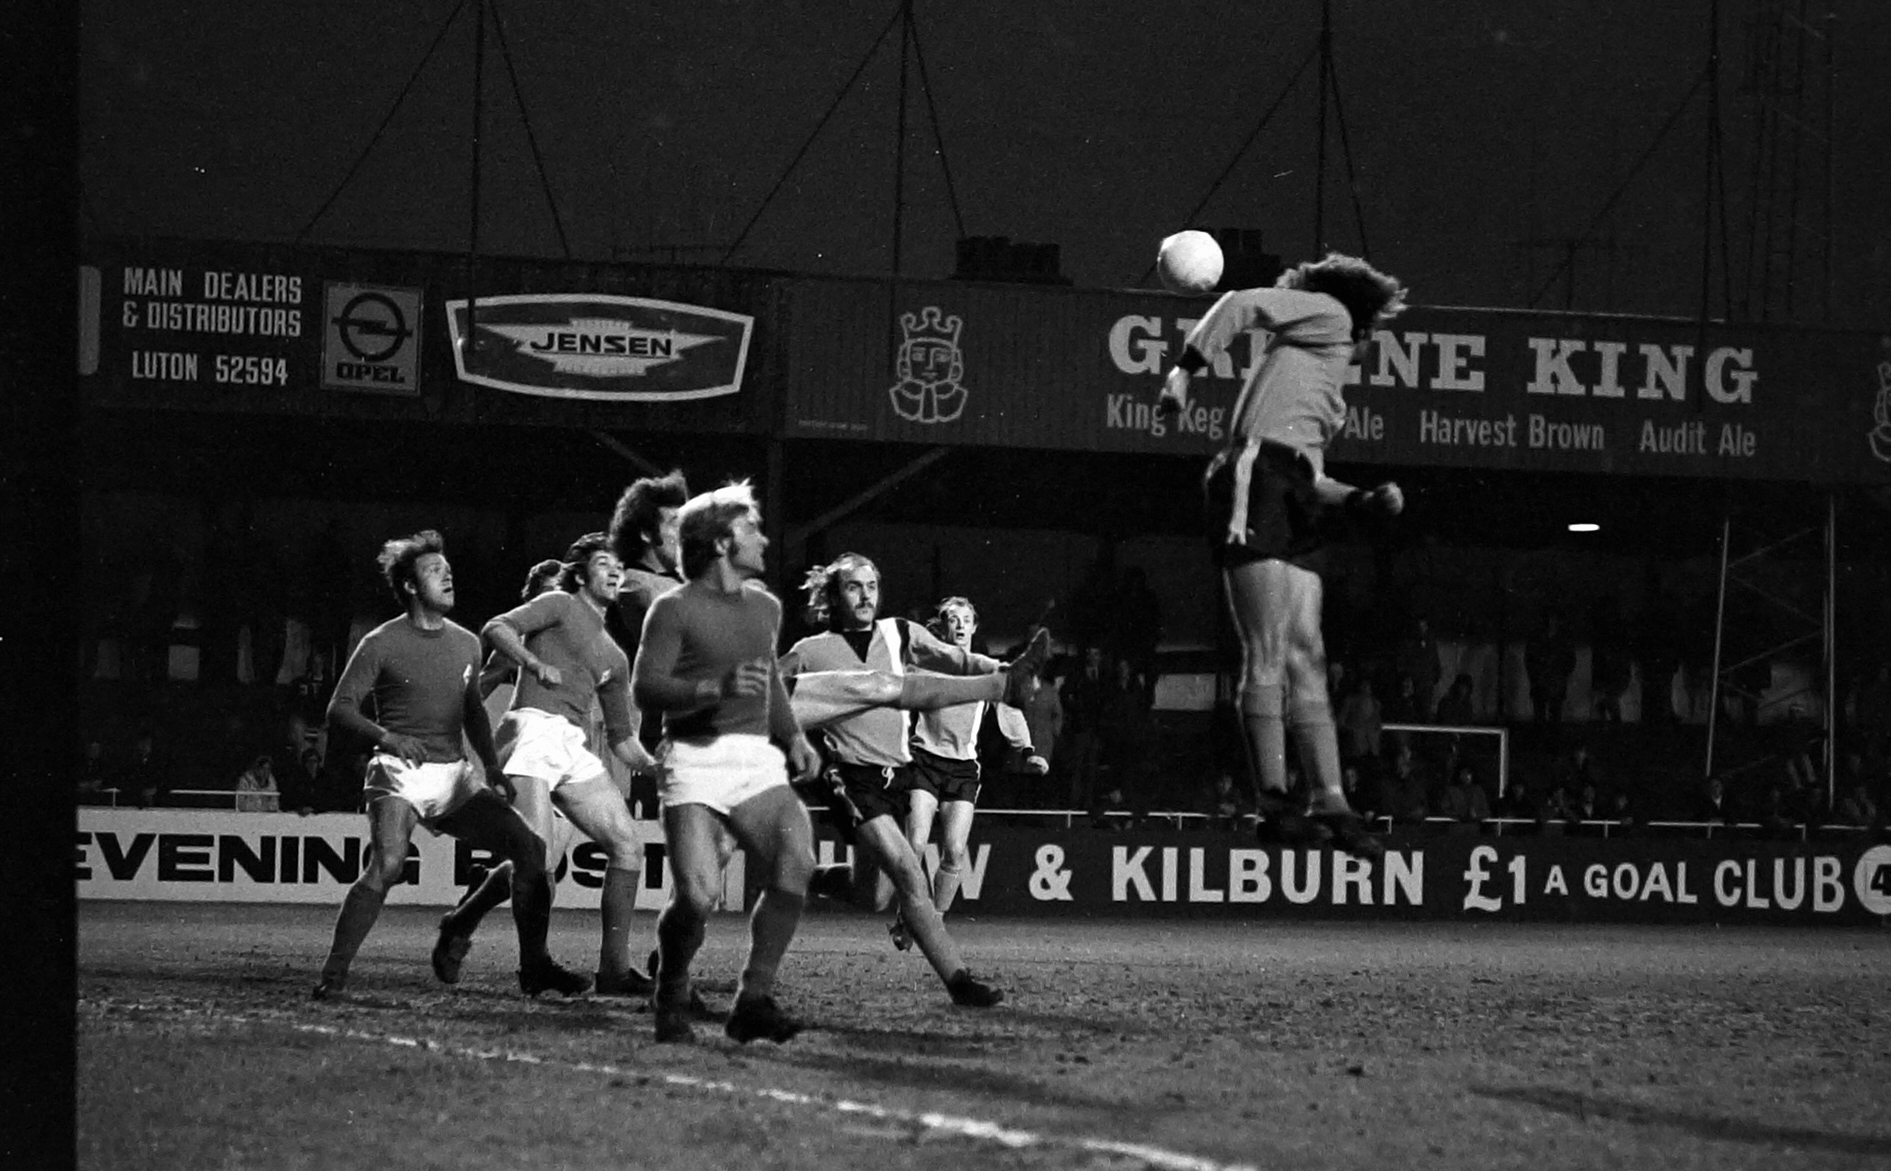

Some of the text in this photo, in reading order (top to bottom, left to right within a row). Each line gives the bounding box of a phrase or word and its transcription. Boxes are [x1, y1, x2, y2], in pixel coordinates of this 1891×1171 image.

[123, 267, 301, 304] MAIN DEALERS
[122, 301, 301, 337] & DISTRIBUTORS
[530, 332, 672, 357] JENSEN
[132, 351, 288, 386] LUTON 52594
[336, 362, 405, 384] OPEL
[1527, 337, 1758, 403] KING
[1107, 395, 1384, 439] King Keg Ale
[1420, 410, 1604, 450] Harvest Brown
[1640, 420, 1756, 457] Audit Ale
[1028, 844, 1073, 901] &
[1112, 846, 1424, 905] KILBURN
[1463, 845, 1844, 913] £1 A GOAL CLUB
